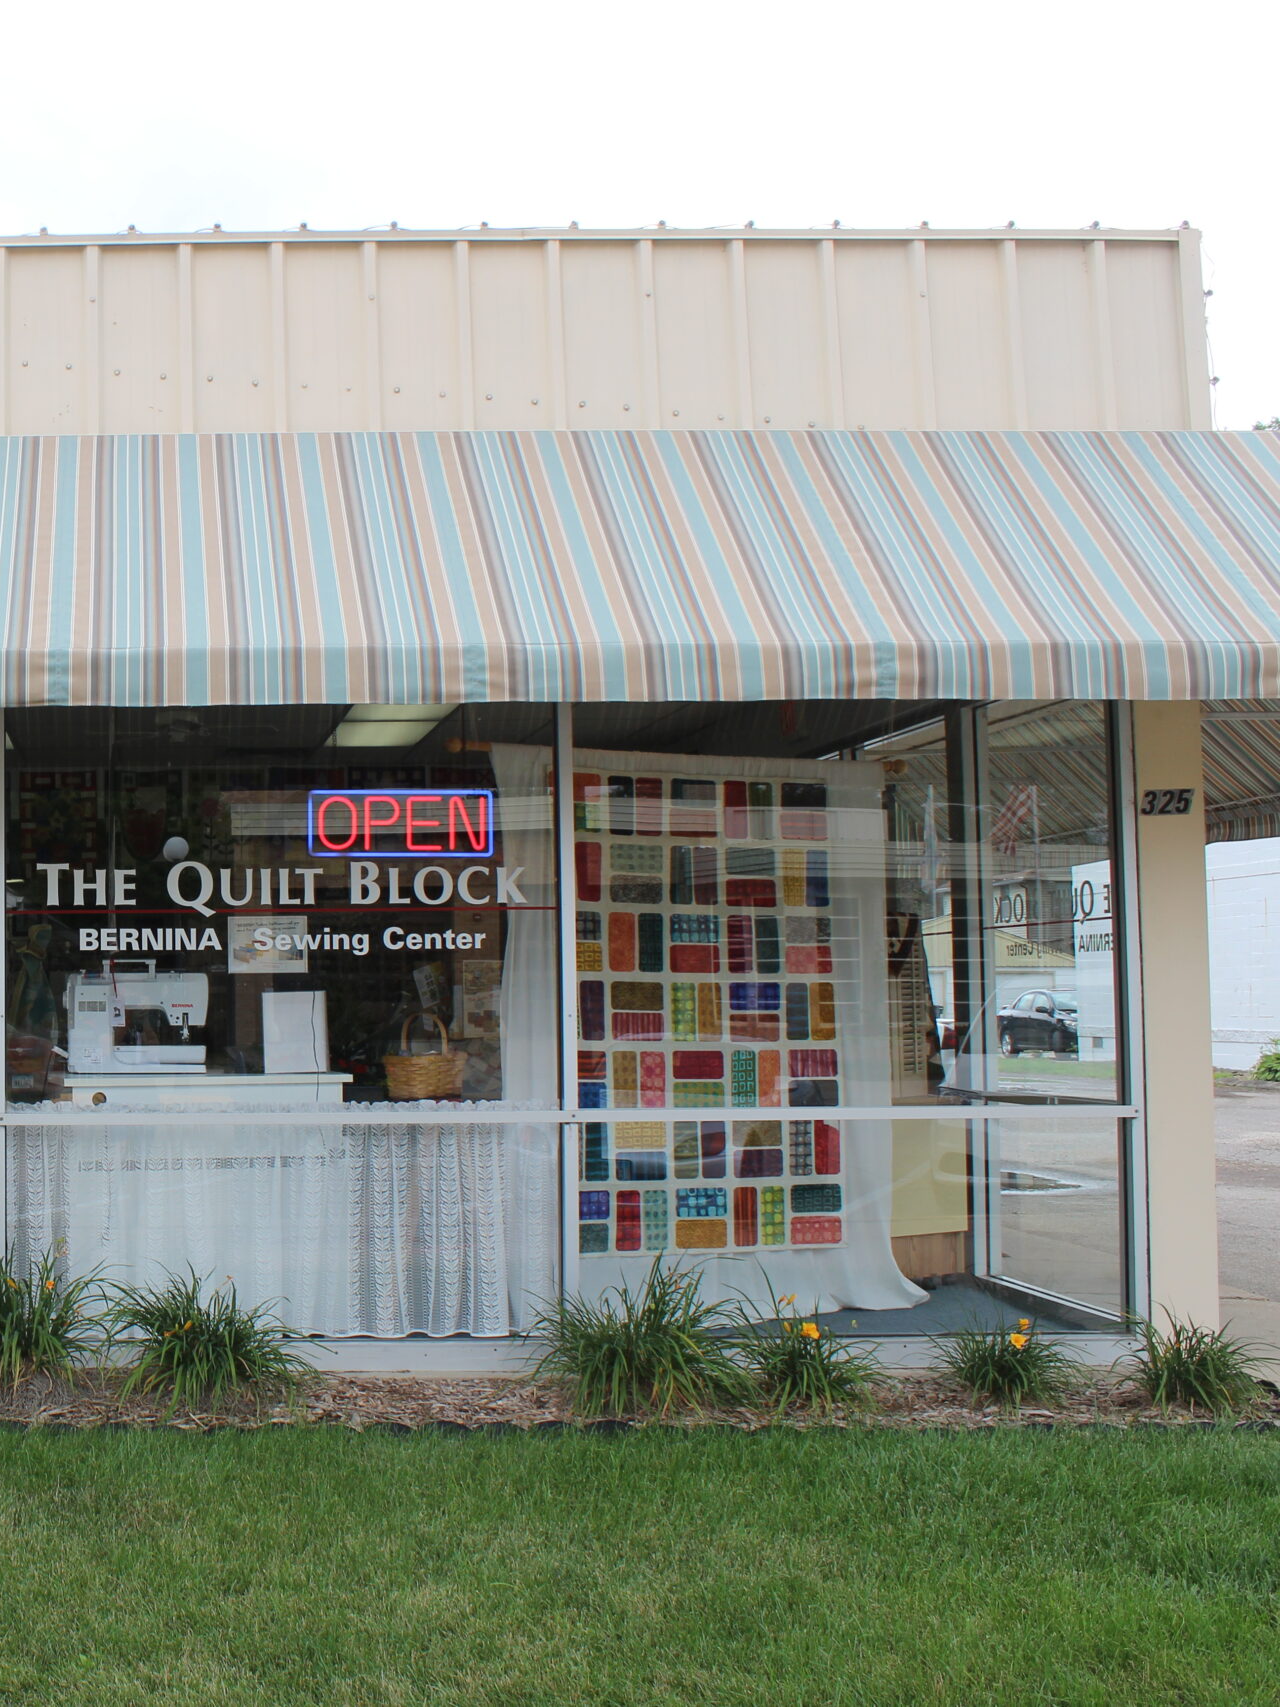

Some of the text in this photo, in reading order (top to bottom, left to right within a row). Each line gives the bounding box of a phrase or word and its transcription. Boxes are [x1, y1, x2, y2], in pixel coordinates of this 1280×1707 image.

[317, 795, 487, 851] OPEN
[1141, 788, 1192, 815] 325
[36, 860, 528, 918] THE QUILT BLOCK
[79, 926, 487, 956] BERNINA Sewing Center
